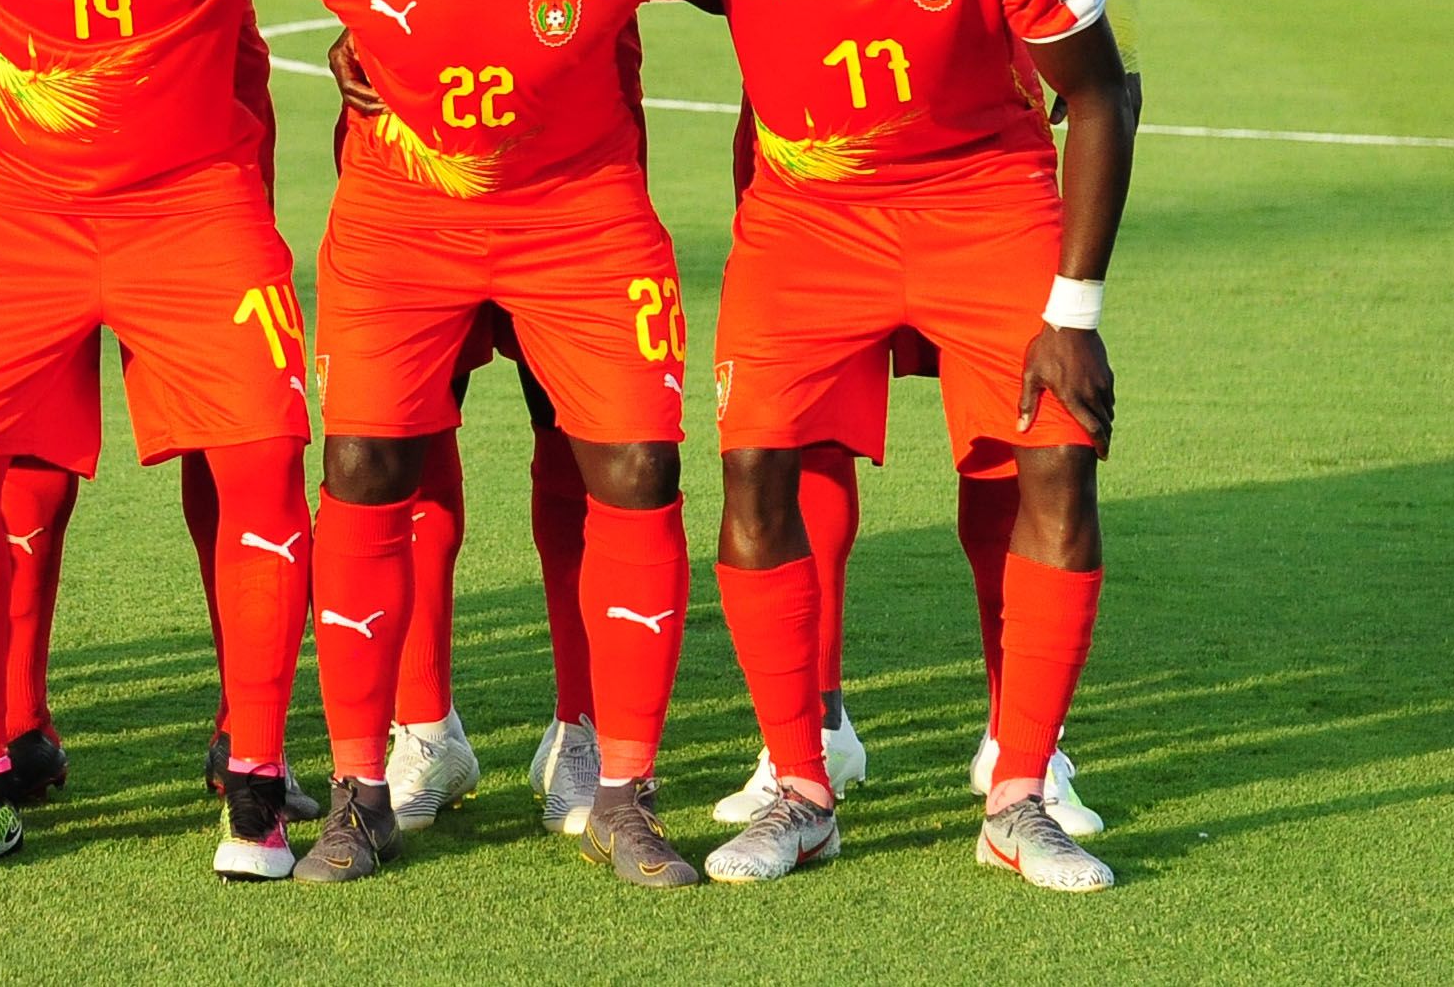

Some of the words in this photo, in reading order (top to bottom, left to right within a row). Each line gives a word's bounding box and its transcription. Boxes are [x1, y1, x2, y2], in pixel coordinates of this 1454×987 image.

[439, 66, 516, 129] 22
[823, 38, 912, 109] 17
[233, 284, 307, 369] 14
[628, 277, 685, 363] 22
